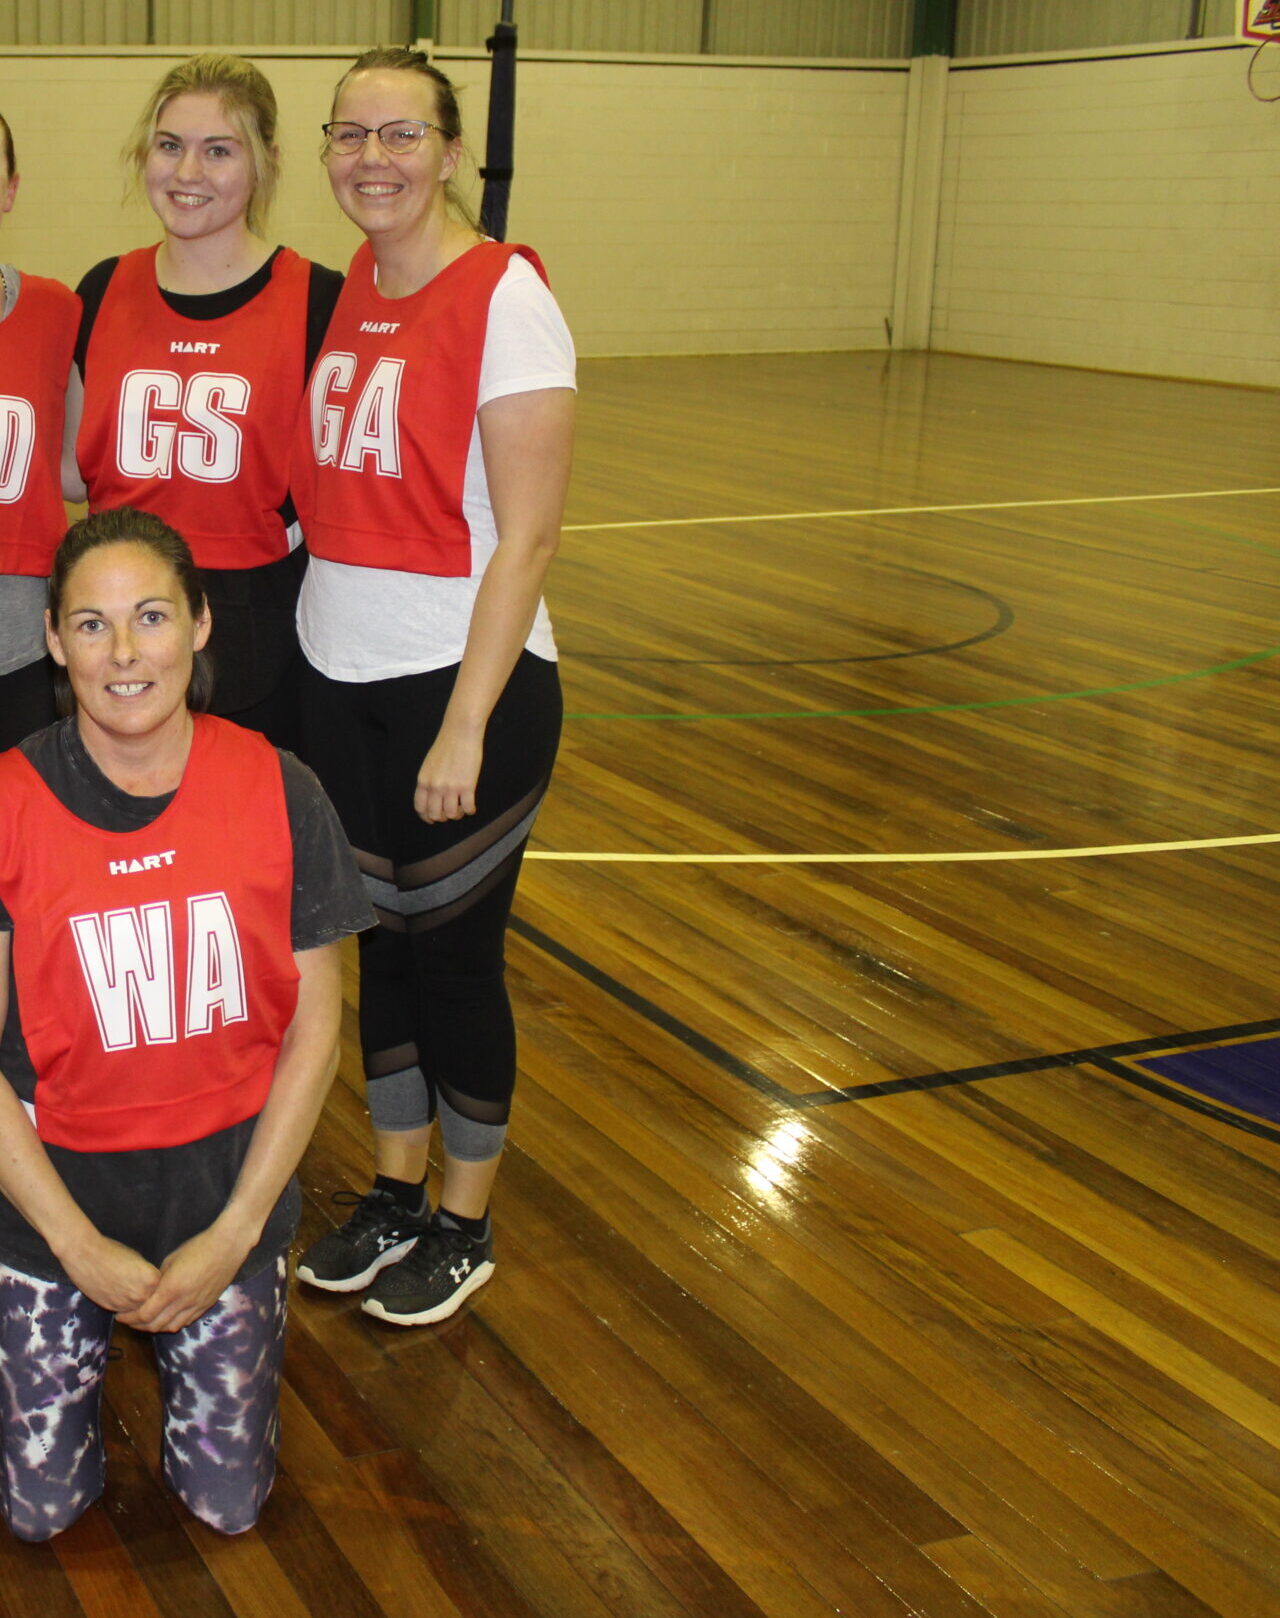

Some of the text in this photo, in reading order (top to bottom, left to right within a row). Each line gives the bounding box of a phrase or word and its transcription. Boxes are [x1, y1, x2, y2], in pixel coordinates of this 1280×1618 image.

[170, 341, 221, 355] HART
[360, 321, 401, 334] HART
[116, 369, 251, 483] GS
[310, 351, 406, 479] GA
[108, 849, 177, 876] HART
[68, 891, 248, 1053] WA
